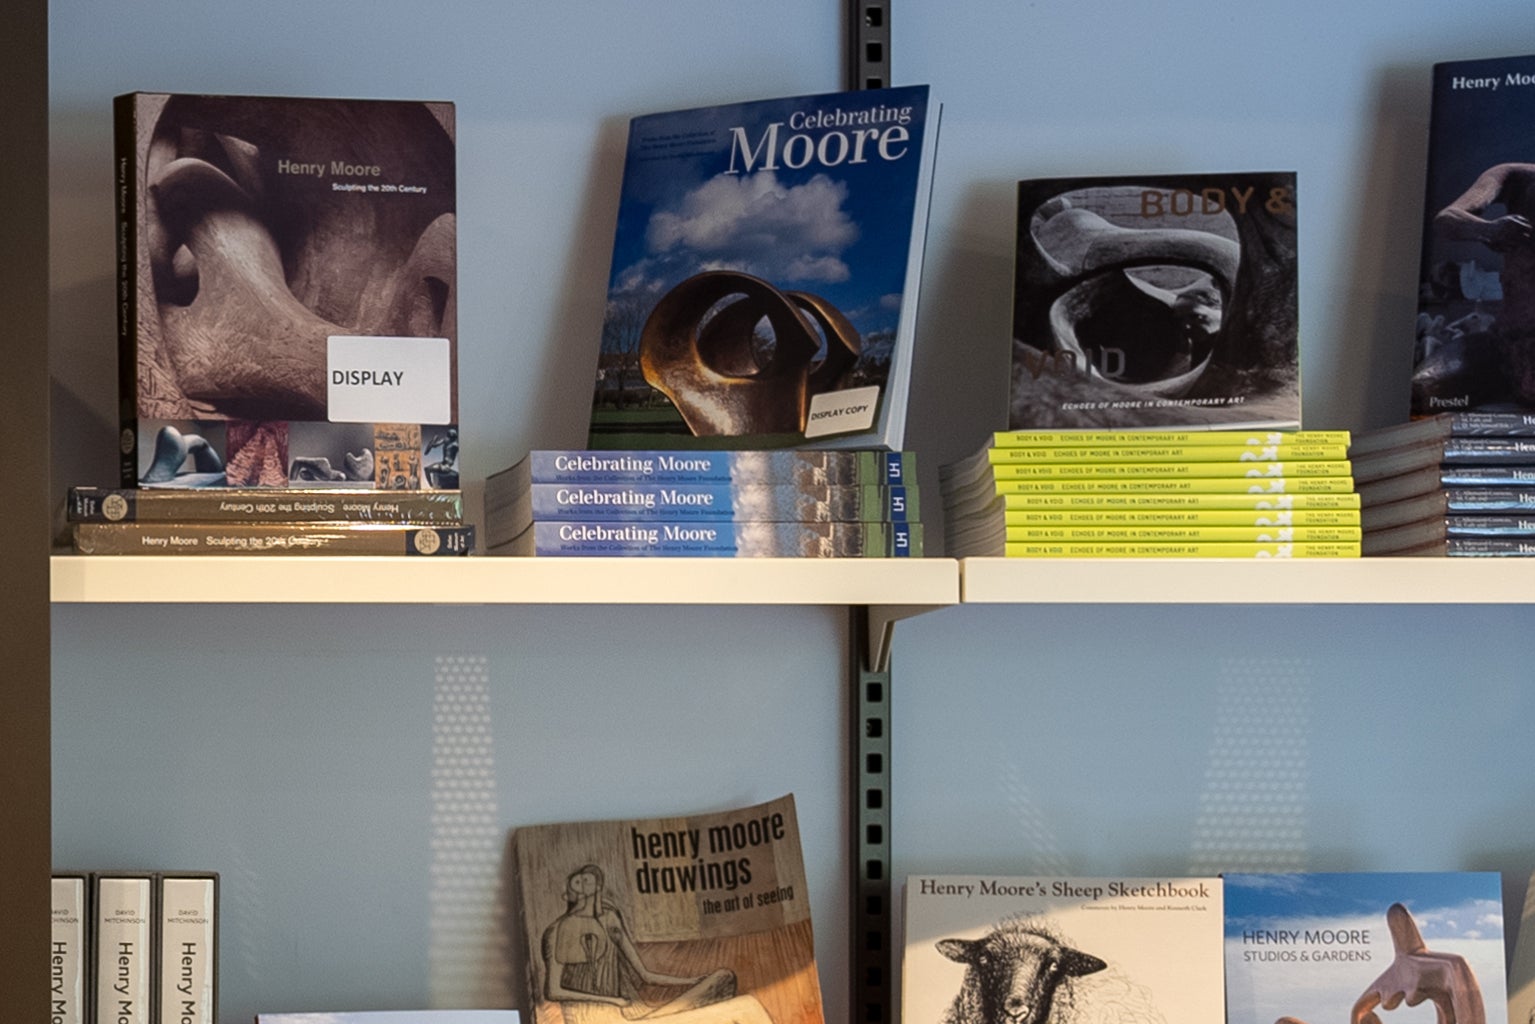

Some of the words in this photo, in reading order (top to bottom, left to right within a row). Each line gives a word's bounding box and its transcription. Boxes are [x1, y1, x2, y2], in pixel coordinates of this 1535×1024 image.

[1452, 77, 1501, 91] Henry
[789, 105, 912, 130] Celebrating
[724, 122, 910, 175] Moore
[278, 160, 325, 178] Henry
[330, 161, 381, 177] Moore
[332, 182, 366, 193] Sculpting
[367, 184, 379, 192] the
[381, 184, 397, 193] 20th
[398, 185, 427, 194] Century
[1141, 186, 1254, 219] BODY
[332, 370, 403, 386] DISPLAY
[1062, 402, 1096, 410] ECHOES
[1098, 402, 1109, 410] OF
[1112, 401, 1141, 409] MOORE
[1156, 398, 1225, 408] CONTEMPORARY
[1227, 396, 1245, 404] ART
[1429, 395, 1469, 407] Prestel
[811, 407, 844, 421] DISPLAY
[845, 404, 868, 415] COPY
[555, 456, 653, 473] Celebrating
[658, 457, 711, 472] Moore
[631, 827, 701, 860] henry
[708, 812, 785, 854] moore
[636, 857, 753, 894] drawings
[920, 879, 974, 898] Henry
[979, 881, 1047, 897] Moore's
[1052, 882, 1103, 900] Sheep
[1108, 882, 1210, 898] Sketchbook
[702, 899, 721, 915] the
[724, 896, 740, 912] art
[743, 893, 755, 910] of
[757, 885, 794, 907] seeing
[1243, 930, 1300, 945] HENRY
[1304, 930, 1370, 945] MOORE
[1244, 951, 1298, 962] STUDIOS
[1300, 951, 1310, 961] &
[1312, 951, 1372, 962] GARDENS
[176, 942, 196, 995] Henry
